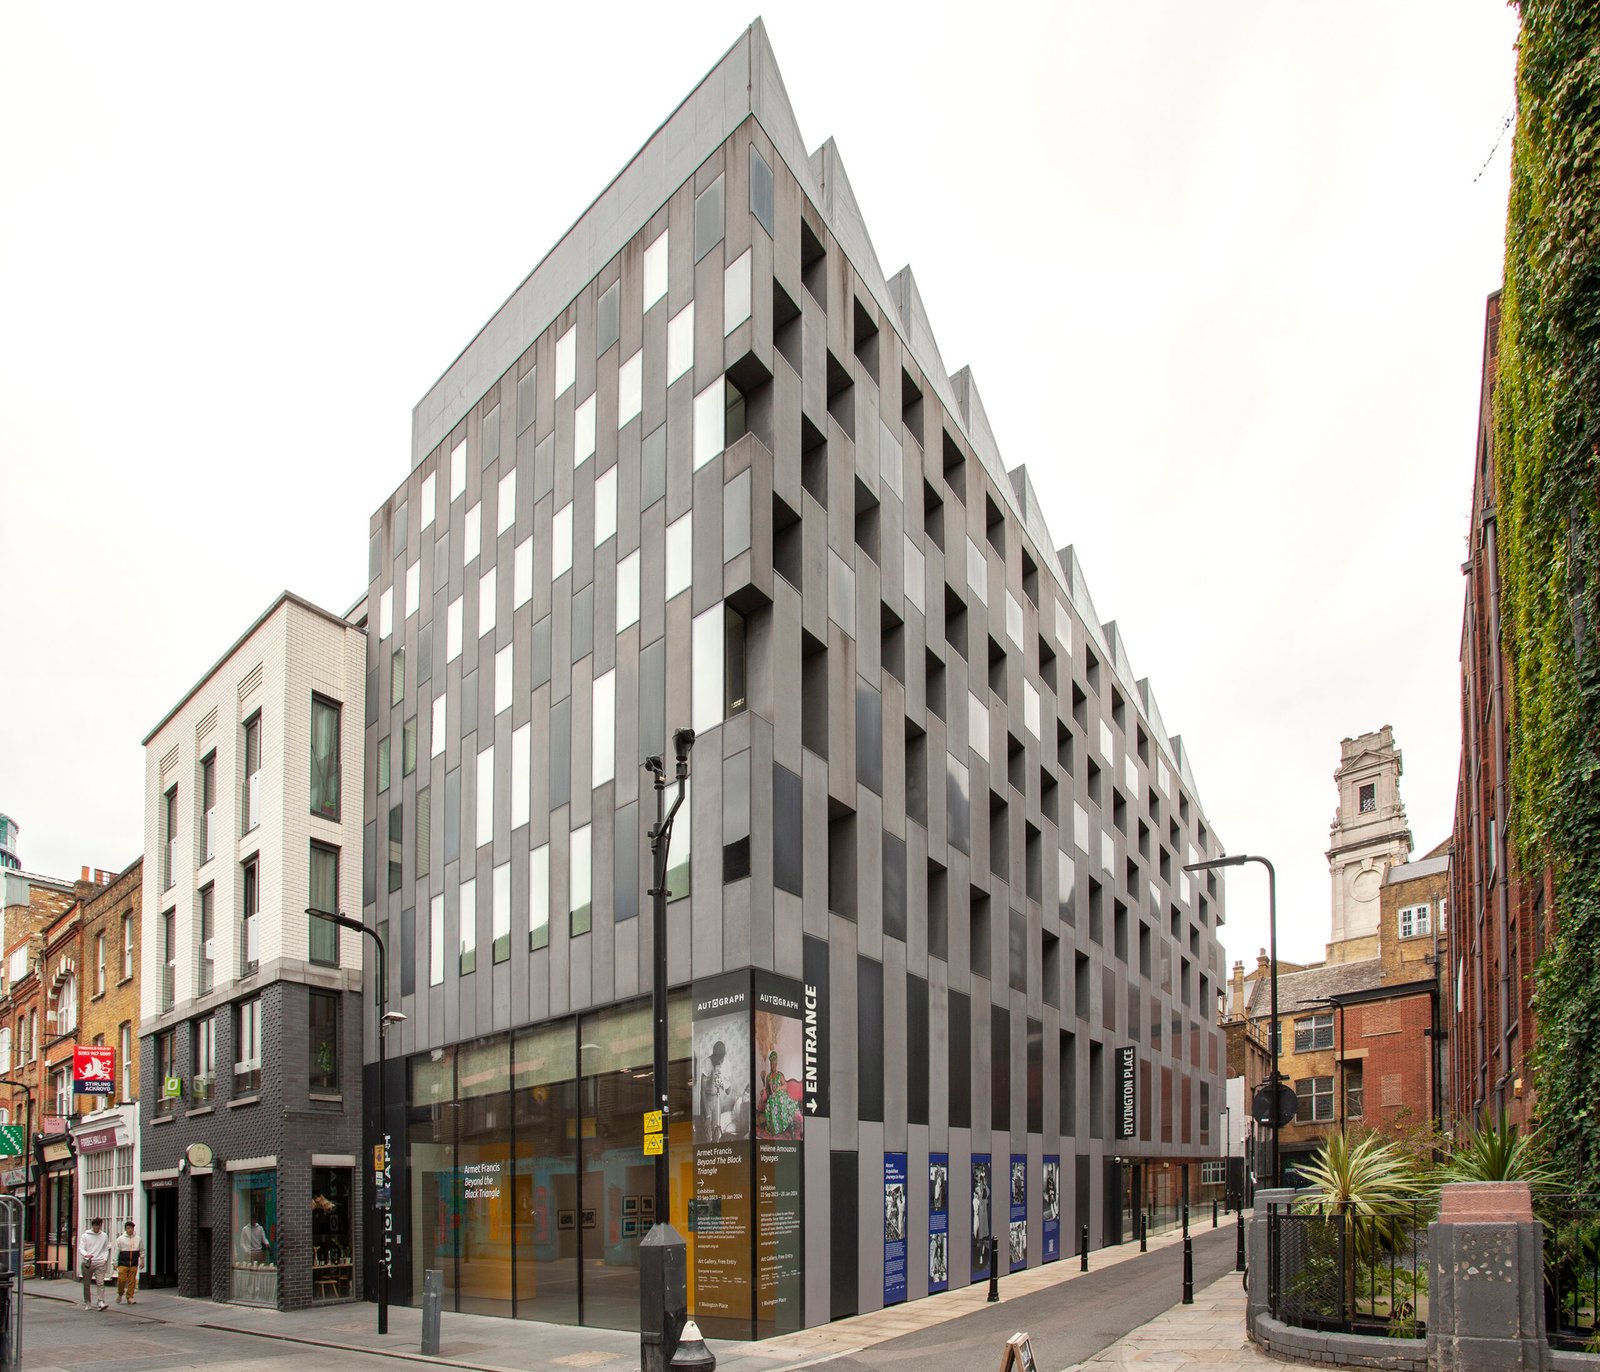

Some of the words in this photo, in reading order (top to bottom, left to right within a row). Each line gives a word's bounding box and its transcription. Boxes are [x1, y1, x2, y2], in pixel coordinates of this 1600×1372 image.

[698, 994, 744, 1010] AUTOGRAPH
[760, 994, 798, 1010] AUTOGRAPH
[805, 984, 818, 1093] ENTRANCE
[1124, 1048, 1133, 1078] PLACE
[1124, 1080, 1133, 1135] RIVINGTON
[714, 1147, 732, 1156] Francis
[697, 1158, 716, 1166] Beyond
[727, 1156, 742, 1164] Black
[464, 1166, 480, 1174] Armet
[481, 1163, 500, 1172] Francis
[698, 1167, 717, 1175] Triangle
[465, 1176, 483, 1187] Beyond
[484, 1176, 493, 1185] the
[465, 1189, 478, 1198] Black
[479, 1188, 500, 1199] Triangle
